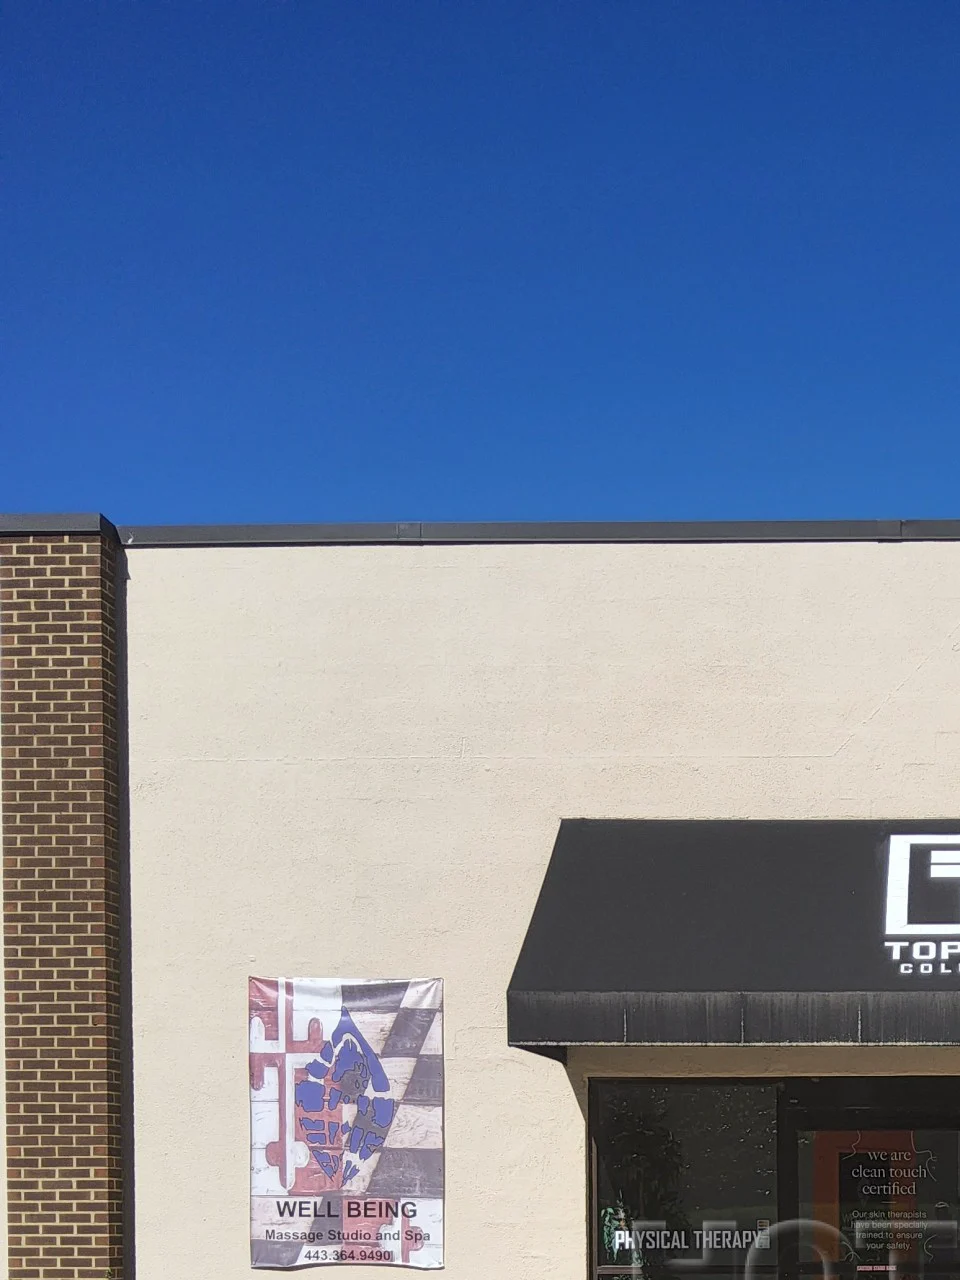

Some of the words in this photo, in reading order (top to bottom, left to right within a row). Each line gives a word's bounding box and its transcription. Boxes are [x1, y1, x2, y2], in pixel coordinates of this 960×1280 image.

[868, 1151, 888, 1161] we
[890, 1151, 912, 1161] are
[851, 1165, 886, 1178] clean
[890, 1165, 927, 1178] touch
[862, 1182, 916, 1195] certified
[277, 1201, 339, 1218] WELL
[347, 1201, 418, 1218] BEING
[851, 1210, 868, 1219] Our
[869, 1210, 886, 1219] skin
[887, 1210, 927, 1221] therapists
[851, 1221, 870, 1229] have
[872, 1221, 892, 1229] been
[894, 1221, 928, 1232] specially
[265, 1229, 324, 1244] Massage
[327, 1228, 372, 1241] Studio
[375, 1228, 401, 1241] and
[404, 1228, 431, 1244] Spa
[615, 1231, 689, 1249] PHYSICAL
[693, 1231, 762, 1249] THERAPY
[866, 1242, 885, 1250] your
[886, 1241, 912, 1250] safety.
[304, 1250, 391, 1261] 443.364.9490
